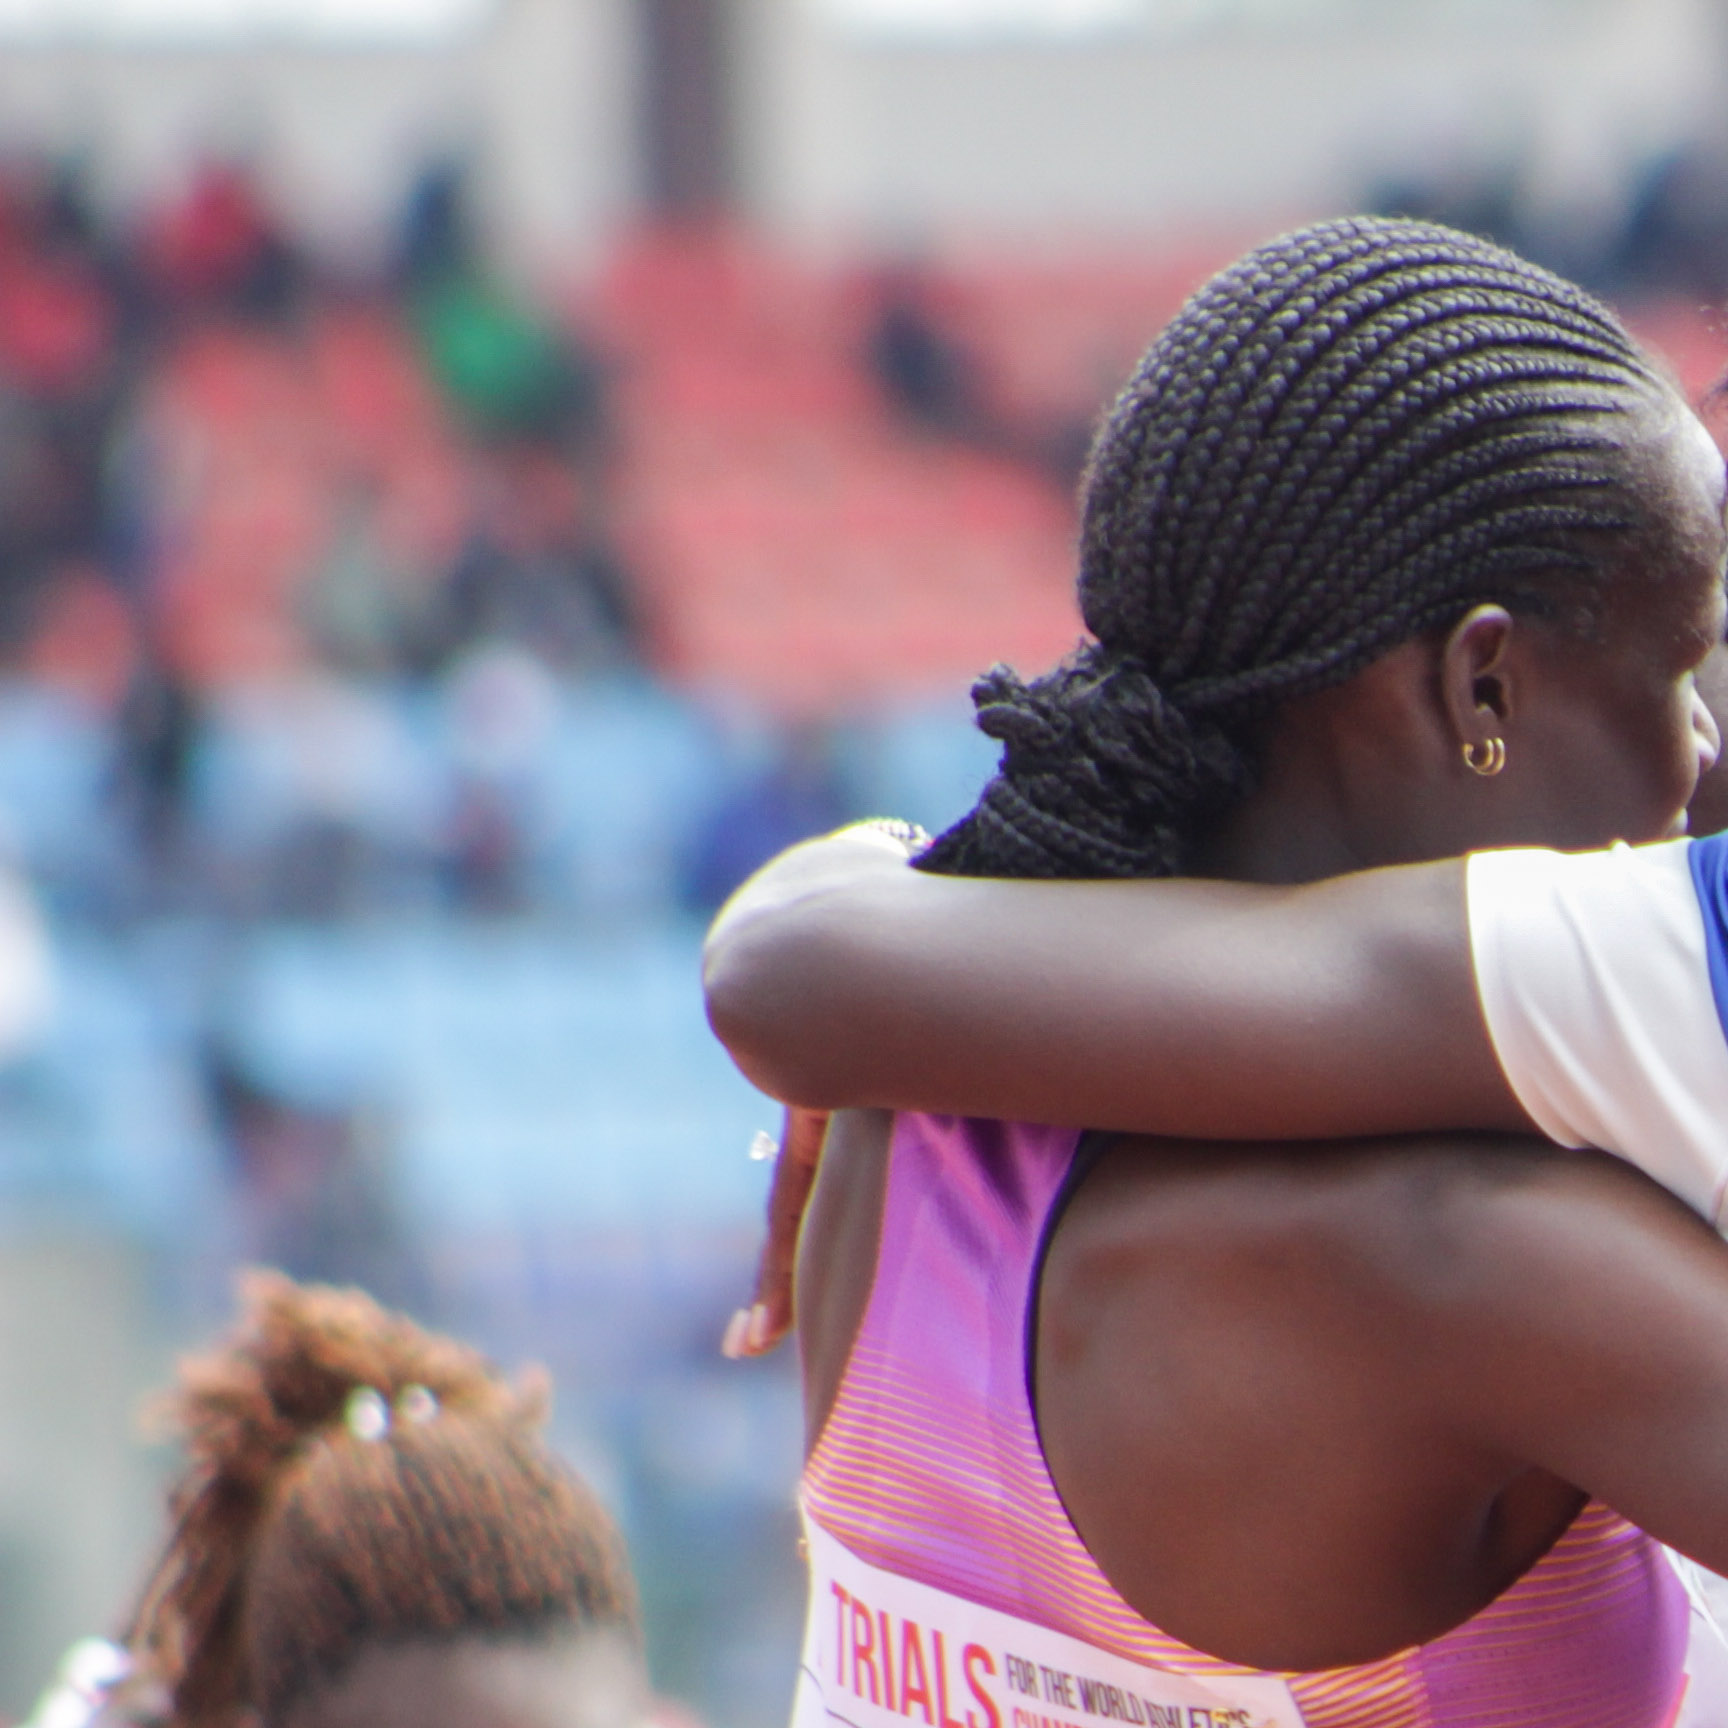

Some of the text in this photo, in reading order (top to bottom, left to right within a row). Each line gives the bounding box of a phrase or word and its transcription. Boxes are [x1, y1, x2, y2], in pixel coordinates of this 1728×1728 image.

[1005, 1653, 1038, 1695] FOR
[1041, 1666, 1076, 1711] THE
[1079, 1678, 1143, 1726] WORLD
